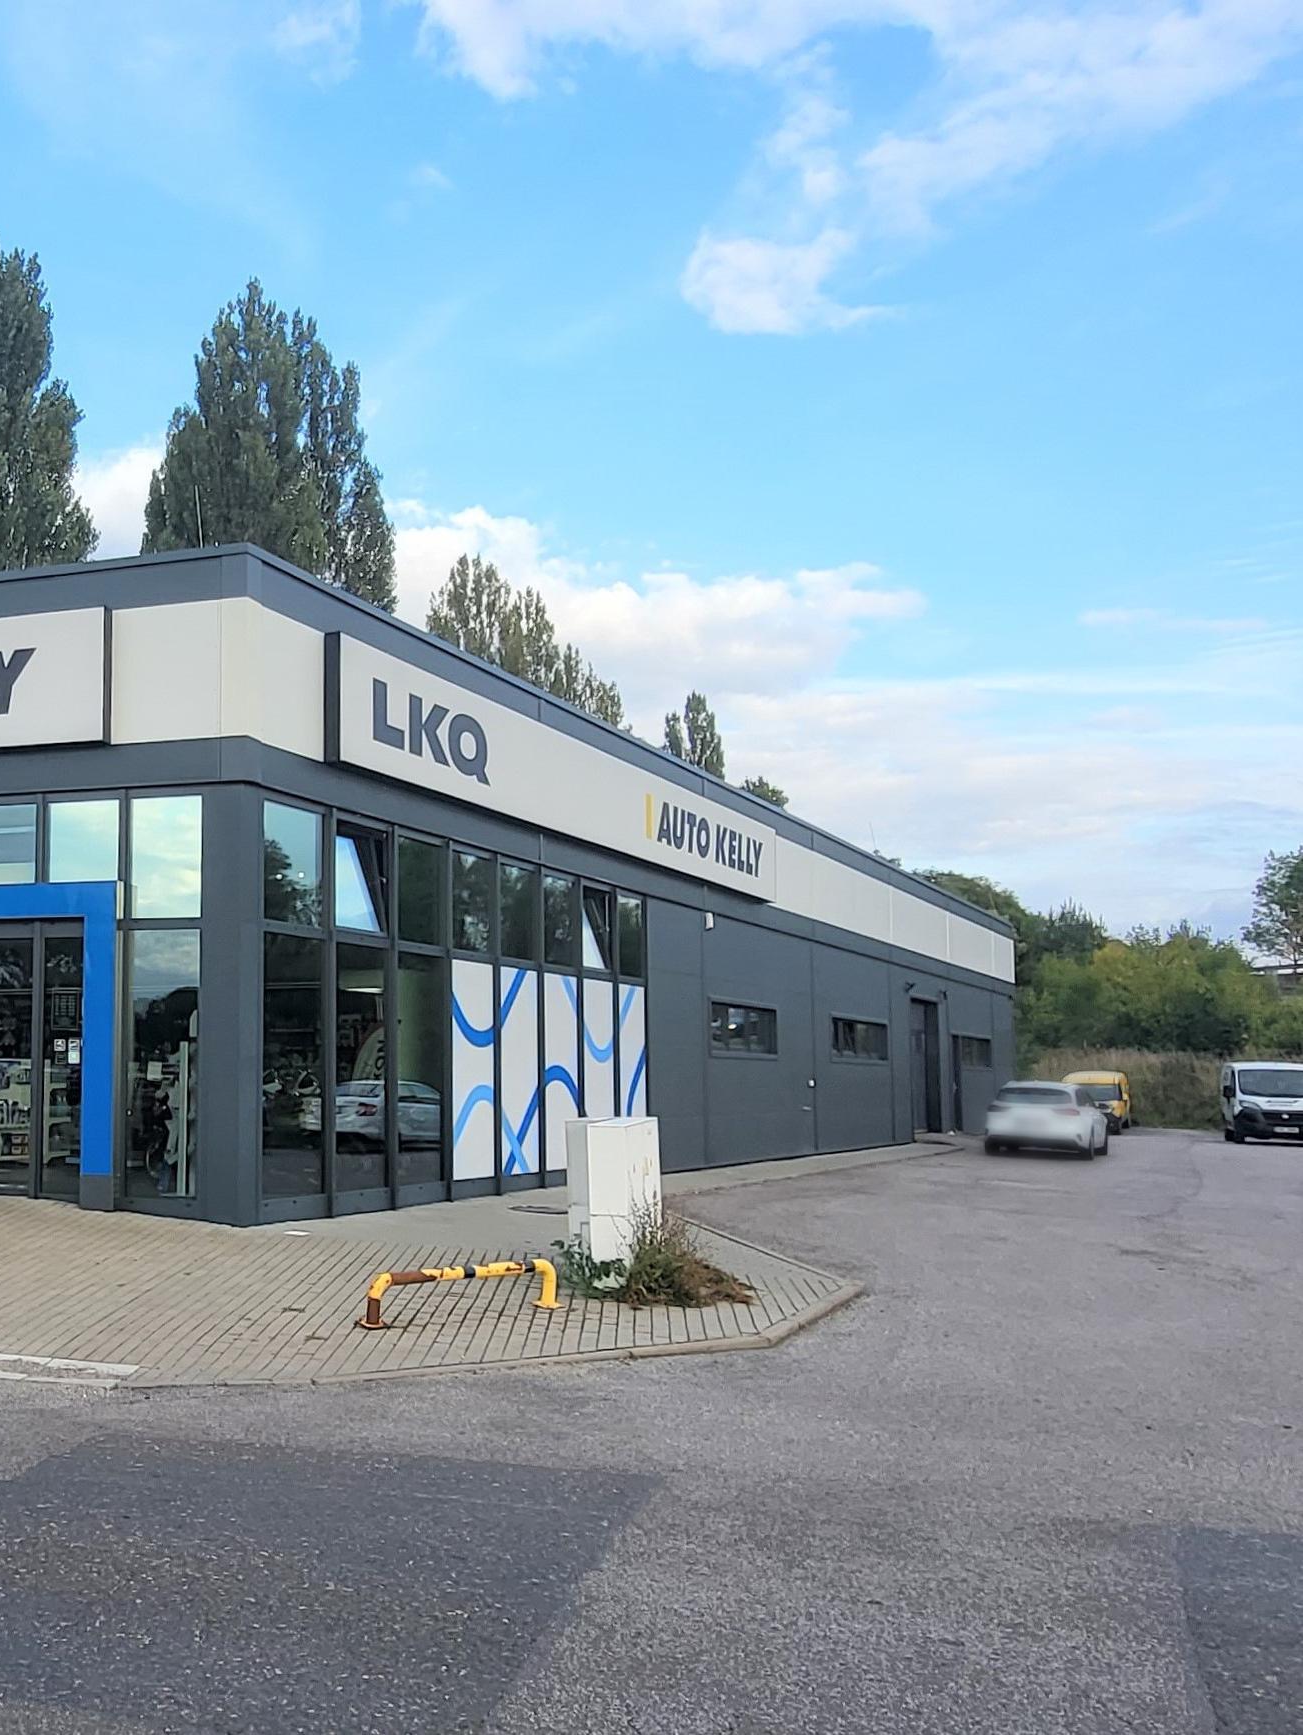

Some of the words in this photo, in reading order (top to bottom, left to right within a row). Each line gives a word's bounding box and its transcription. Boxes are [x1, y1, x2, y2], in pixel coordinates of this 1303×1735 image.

[372, 677, 491, 787] LKQ
[656, 801, 711, 860] AUTO
[714, 823, 765, 879] KELLY
